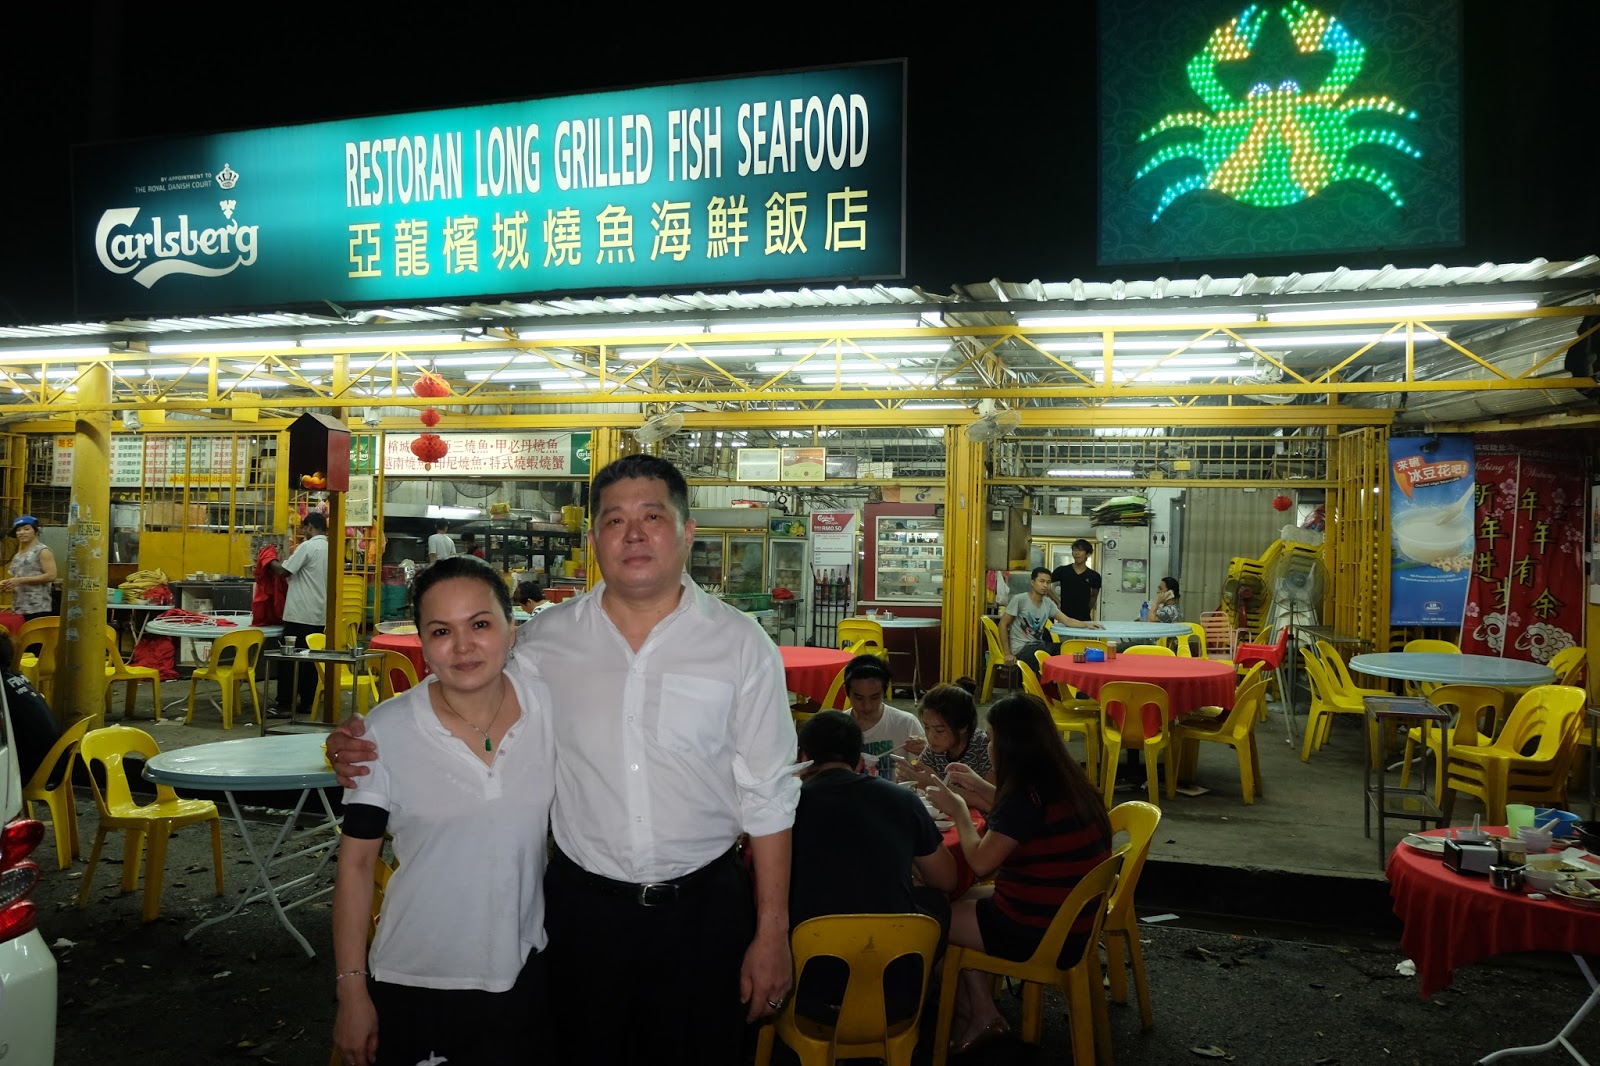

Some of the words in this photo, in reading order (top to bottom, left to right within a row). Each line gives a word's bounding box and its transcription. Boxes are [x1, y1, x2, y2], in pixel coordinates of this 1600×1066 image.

[135, 186, 147, 194] THE
[147, 184, 167, 193] ROYAL
[168, 182, 191, 191] DANISH
[191, 180, 212, 189] COURT
[160, 175, 168, 183] BY
[168, 173, 202, 182] APPOINTMENT
[345, 131, 462, 208] RESTORAN
[475, 123, 540, 197] LONG
[553, 114, 653, 191] GRILLED
[668, 106, 722, 182] FISH
[737, 93, 869, 177] SEAFOOD
[95, 207, 259, 288] Carlsberg
[348, 186, 869, 279] 亞龍檳城燒魚海鮮飯店
[1512, 487, 1567, 619] 年年有余
